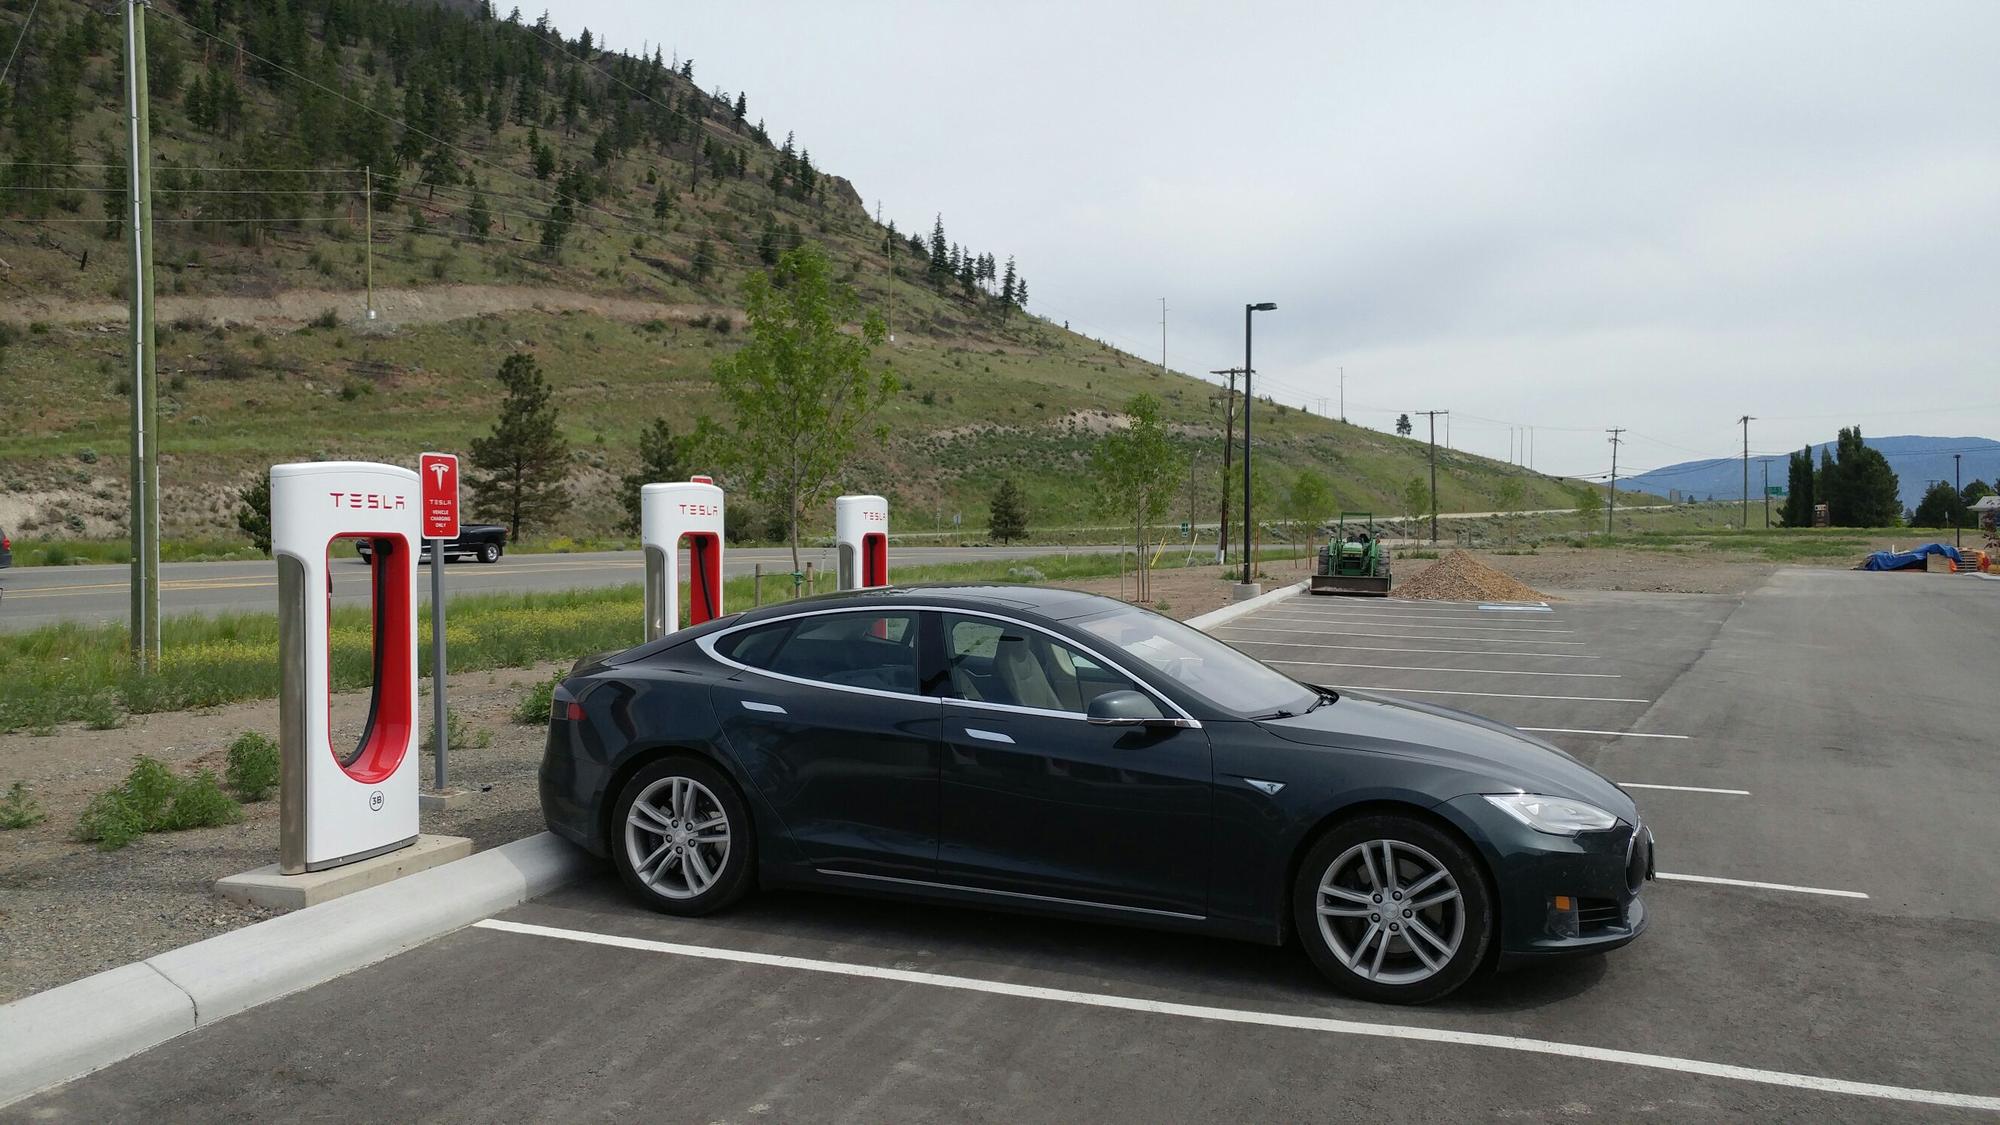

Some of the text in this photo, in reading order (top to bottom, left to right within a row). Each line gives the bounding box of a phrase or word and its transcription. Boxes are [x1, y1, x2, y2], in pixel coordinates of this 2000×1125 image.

[329, 492, 405, 510] TESLA
[679, 504, 718, 516] TESLA
[863, 511, 886, 520] TESLA
[372, 795, 382, 805] 3B
